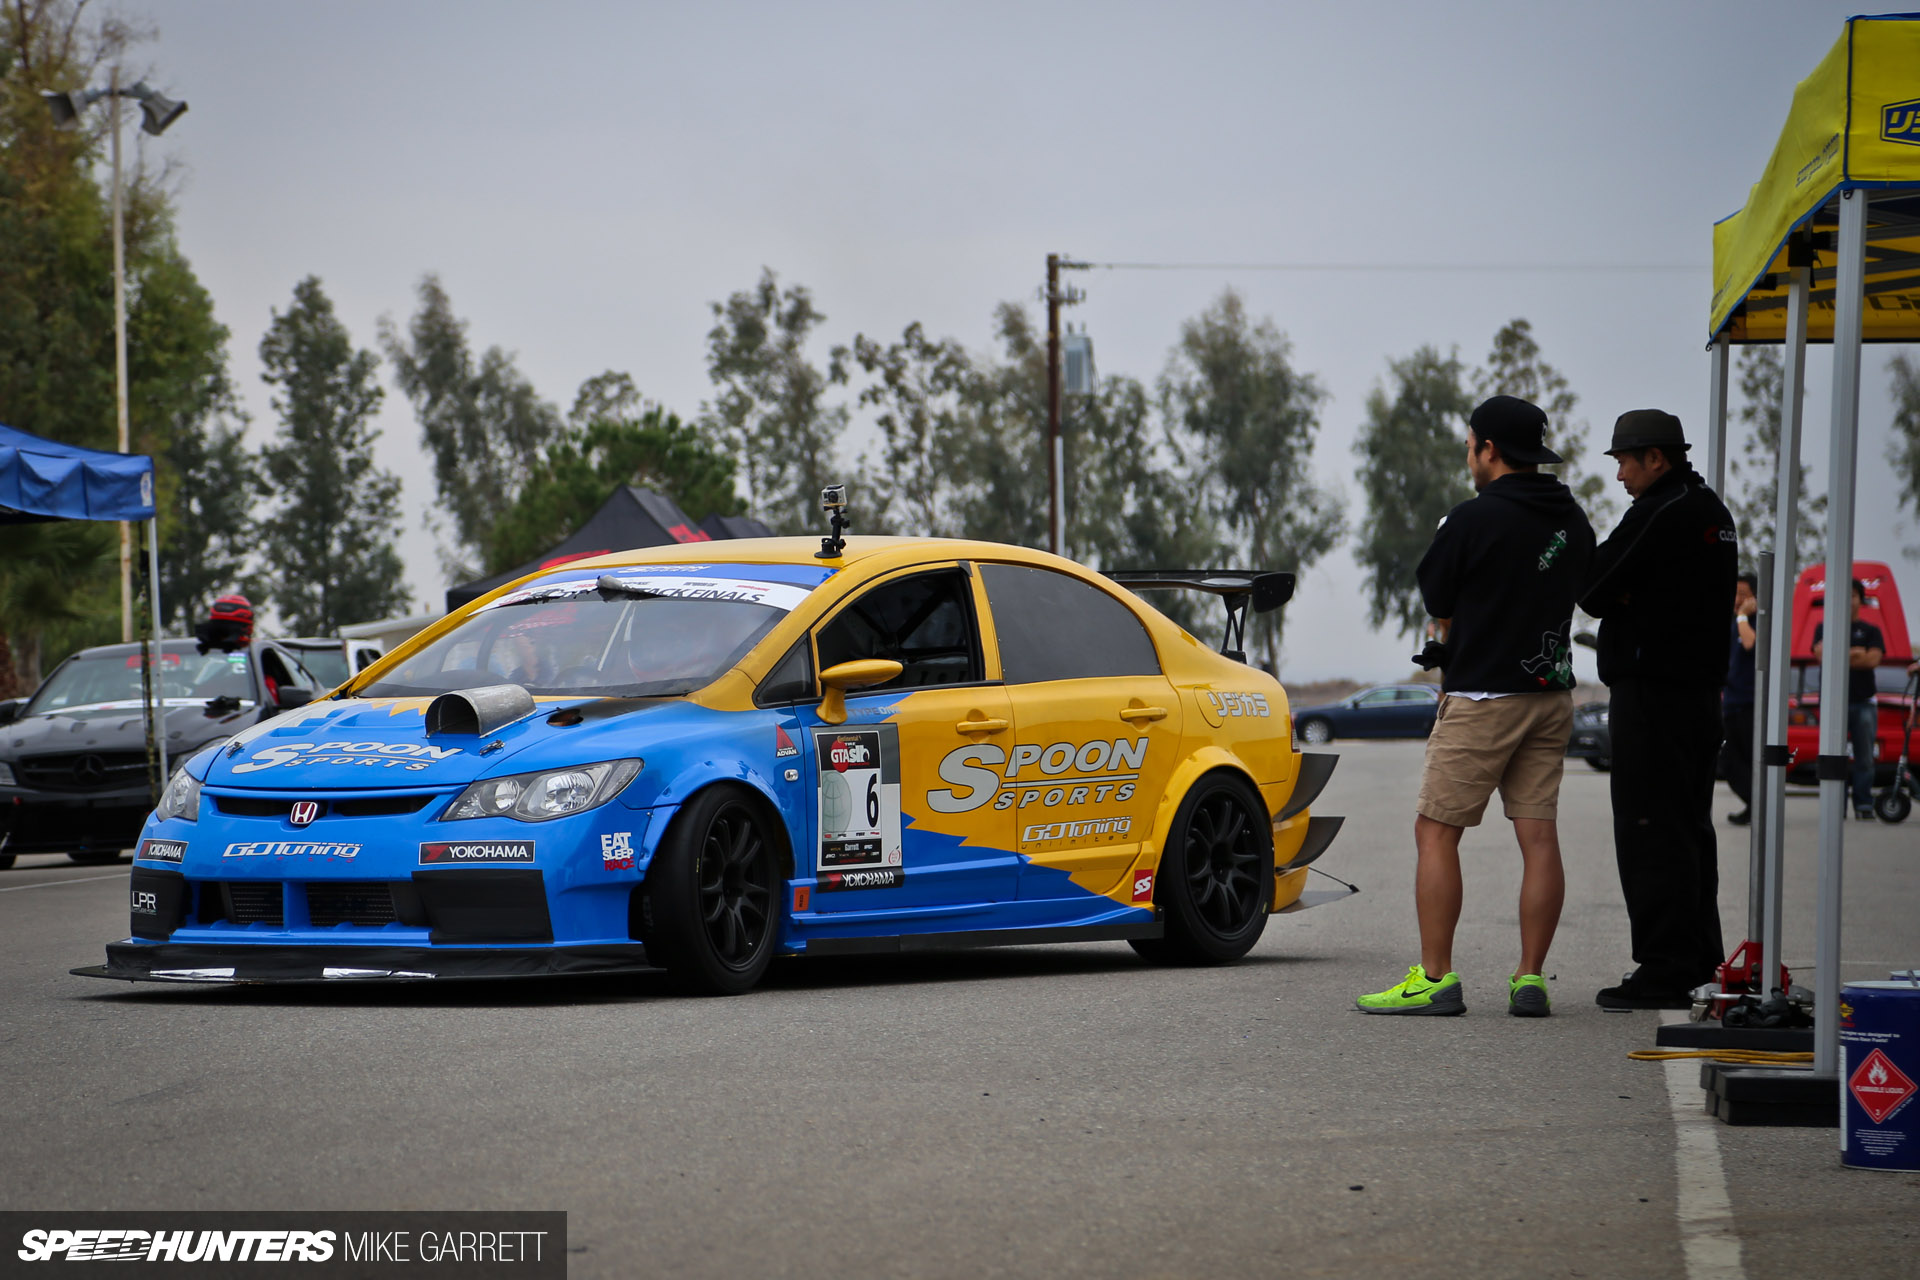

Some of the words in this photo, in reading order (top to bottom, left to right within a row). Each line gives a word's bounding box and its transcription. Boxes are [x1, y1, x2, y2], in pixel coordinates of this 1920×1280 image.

[231, 741, 464, 774] SPOON
[777, 749, 797, 757] ADVAN
[284, 757, 430, 771] SPORTS
[926, 737, 1149, 813] SPOON
[866, 773, 879, 828] 6
[994, 783, 1136, 810] SPORTS
[600, 832, 632, 851] EAT
[148, 843, 182, 858] YOKOHAMA
[449, 845, 529, 858] YOKOHAMA
[602, 847, 634, 861] SLEEP
[604, 856, 636, 871] RACE
[842, 871, 895, 888] YOKOHAMA
[132, 891, 157, 910] LPR
